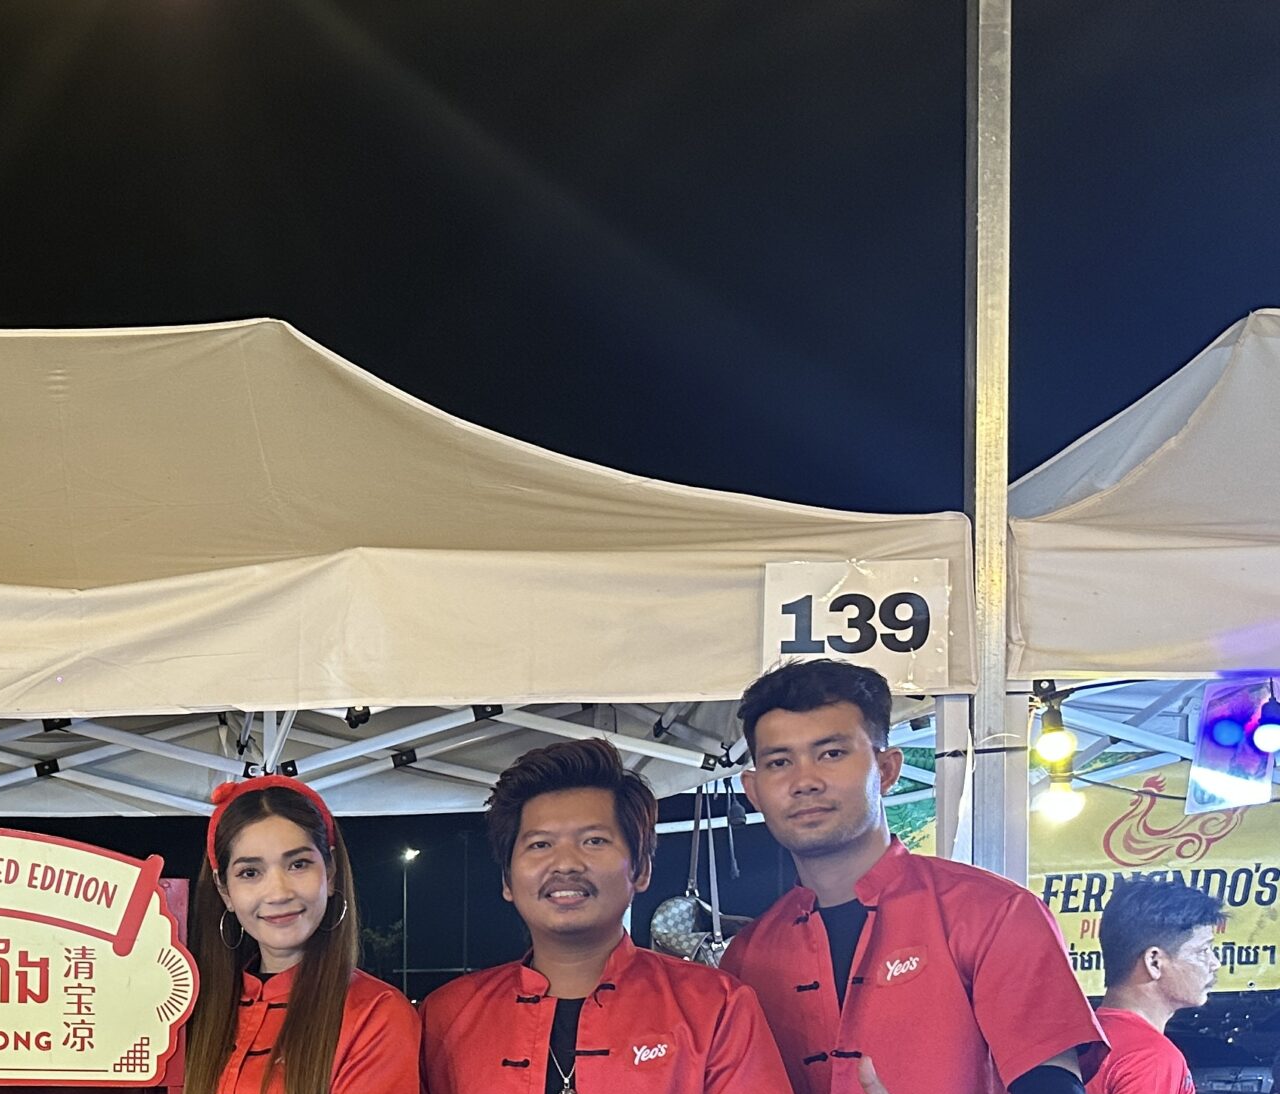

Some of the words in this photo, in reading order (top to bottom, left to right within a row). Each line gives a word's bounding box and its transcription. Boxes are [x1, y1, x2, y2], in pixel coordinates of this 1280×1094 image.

[781, 592, 930, 654] 139
[28, 863, 119, 909] EDITION
[885, 956, 920, 981] Yeo's
[62, 945, 98, 1053] 清宝凉
[632, 1042, 669, 1066] Yeo's
